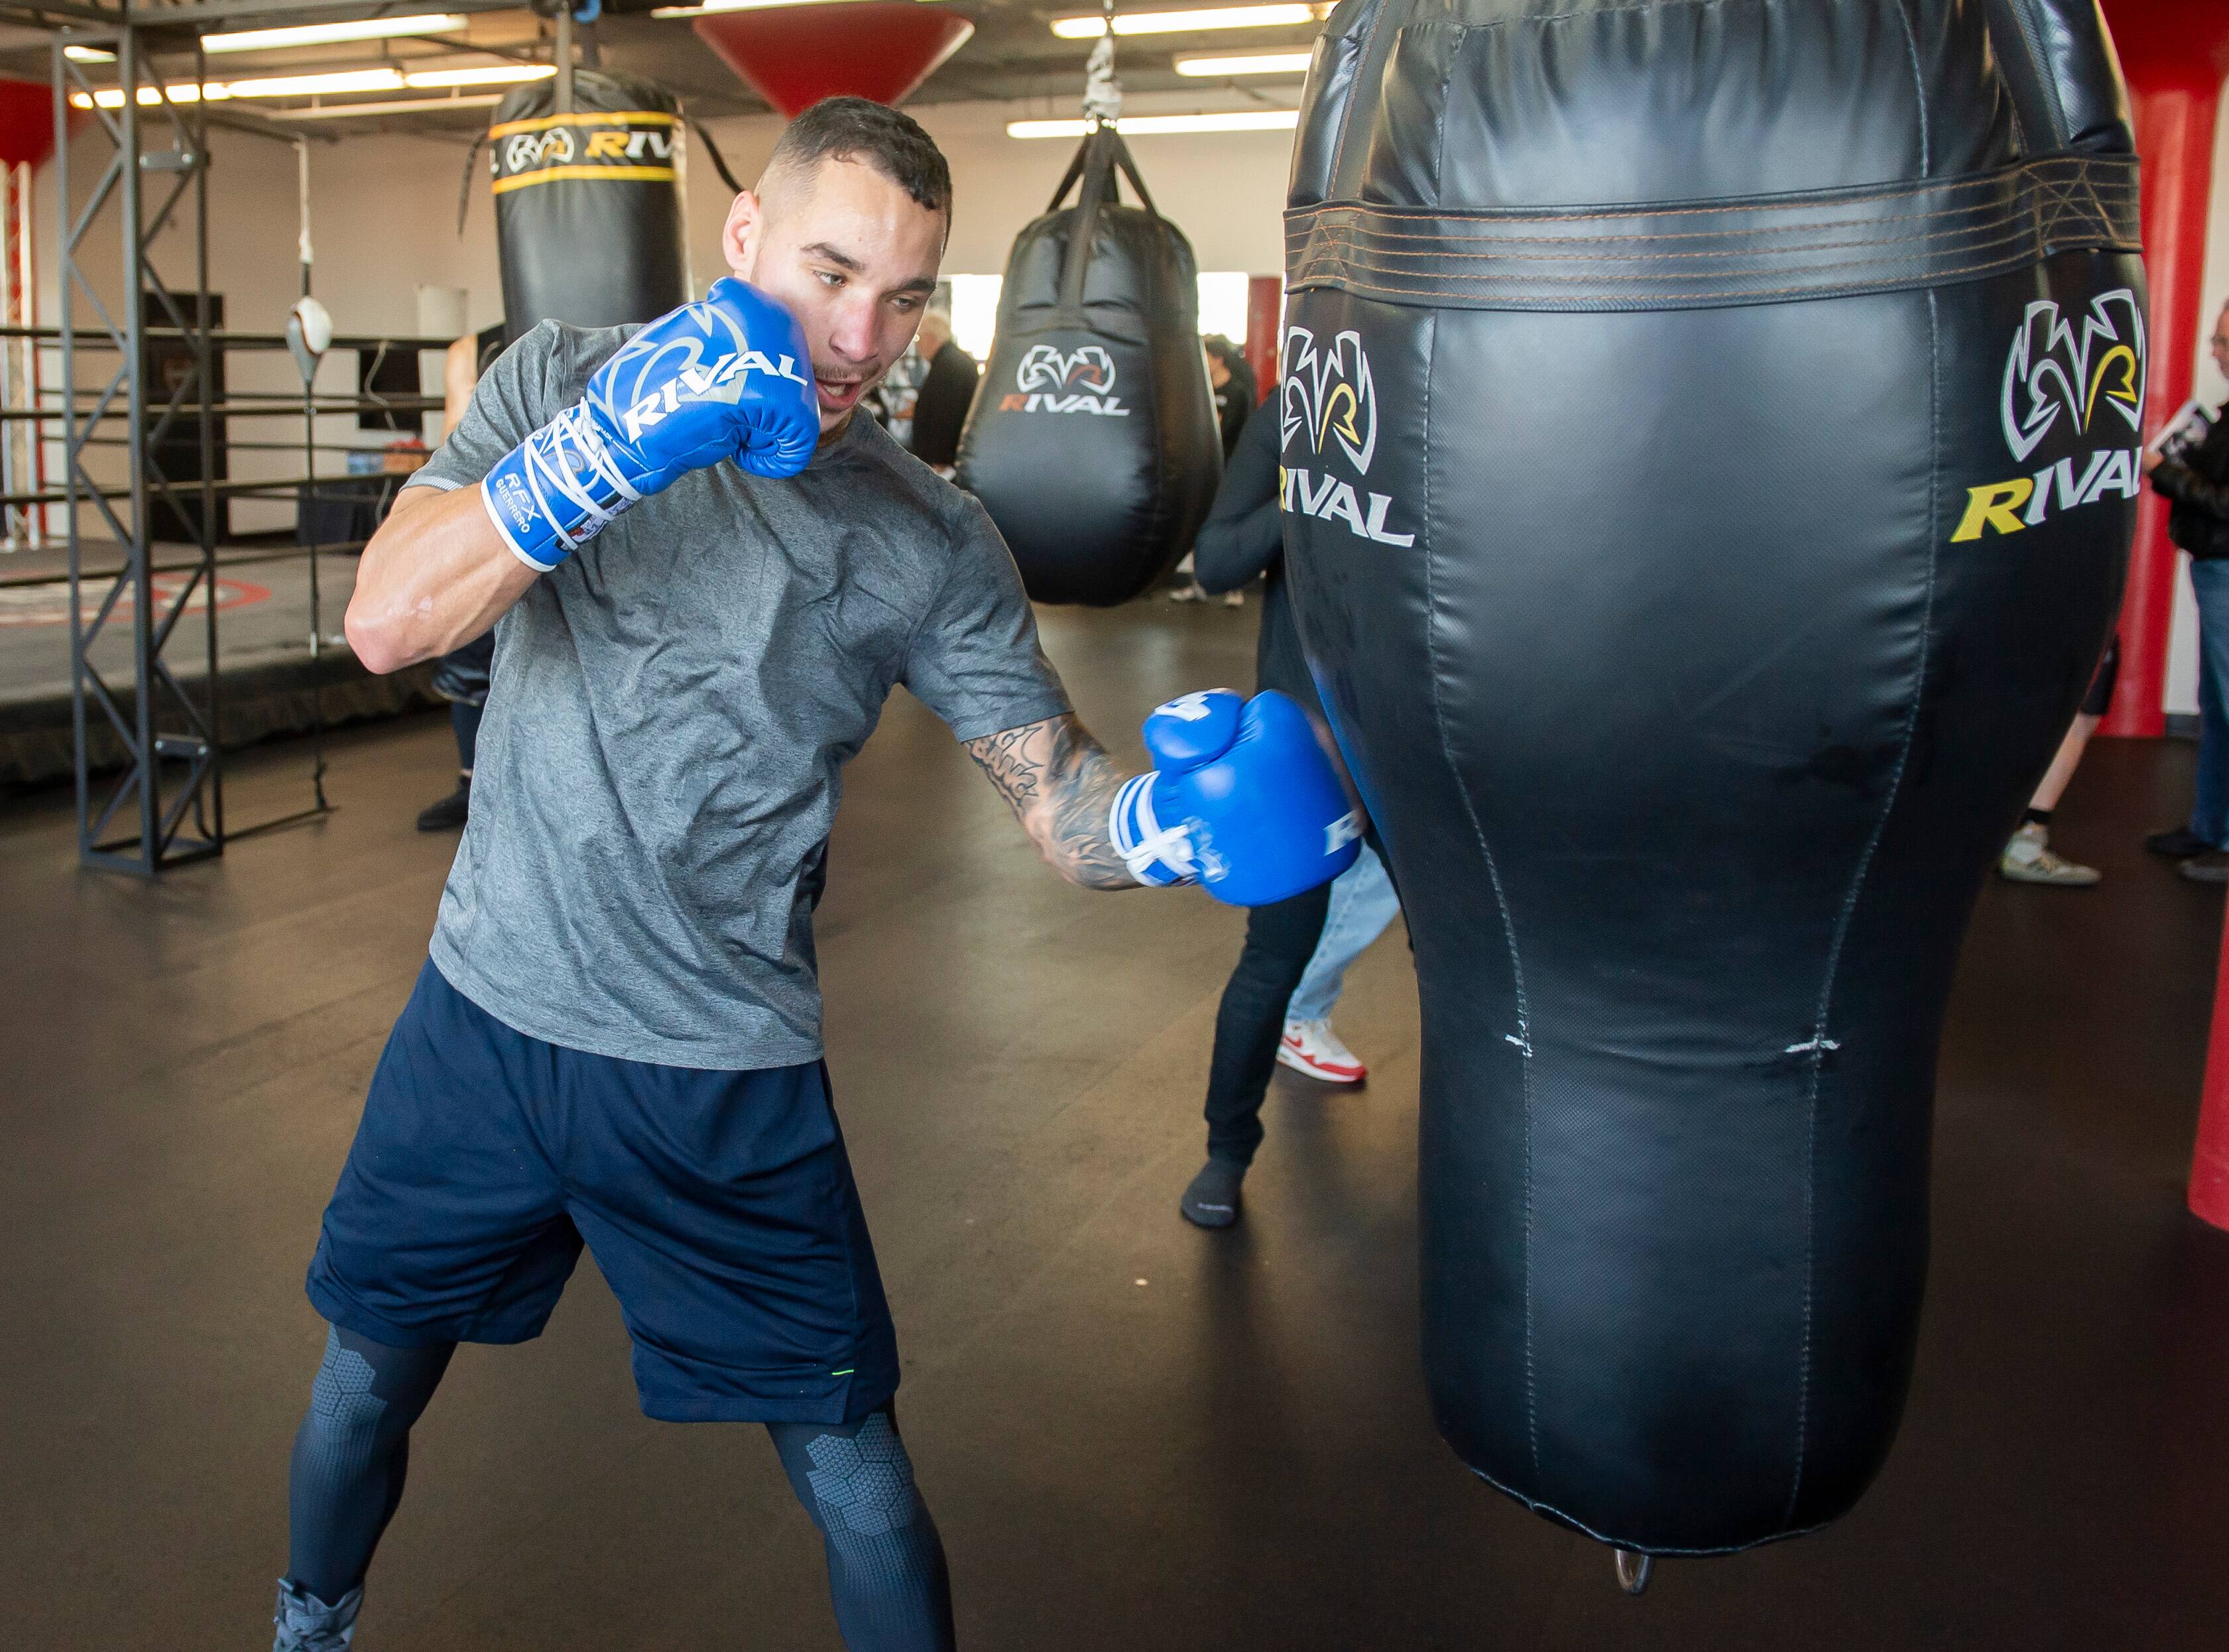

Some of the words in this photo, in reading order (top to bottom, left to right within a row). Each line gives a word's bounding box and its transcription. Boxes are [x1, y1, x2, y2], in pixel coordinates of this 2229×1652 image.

[622, 351, 808, 444] RIVAL
[999, 393, 1130, 416] RIVAL
[495, 478, 530, 534] GUERRERO
[505, 473, 542, 522] RFX
